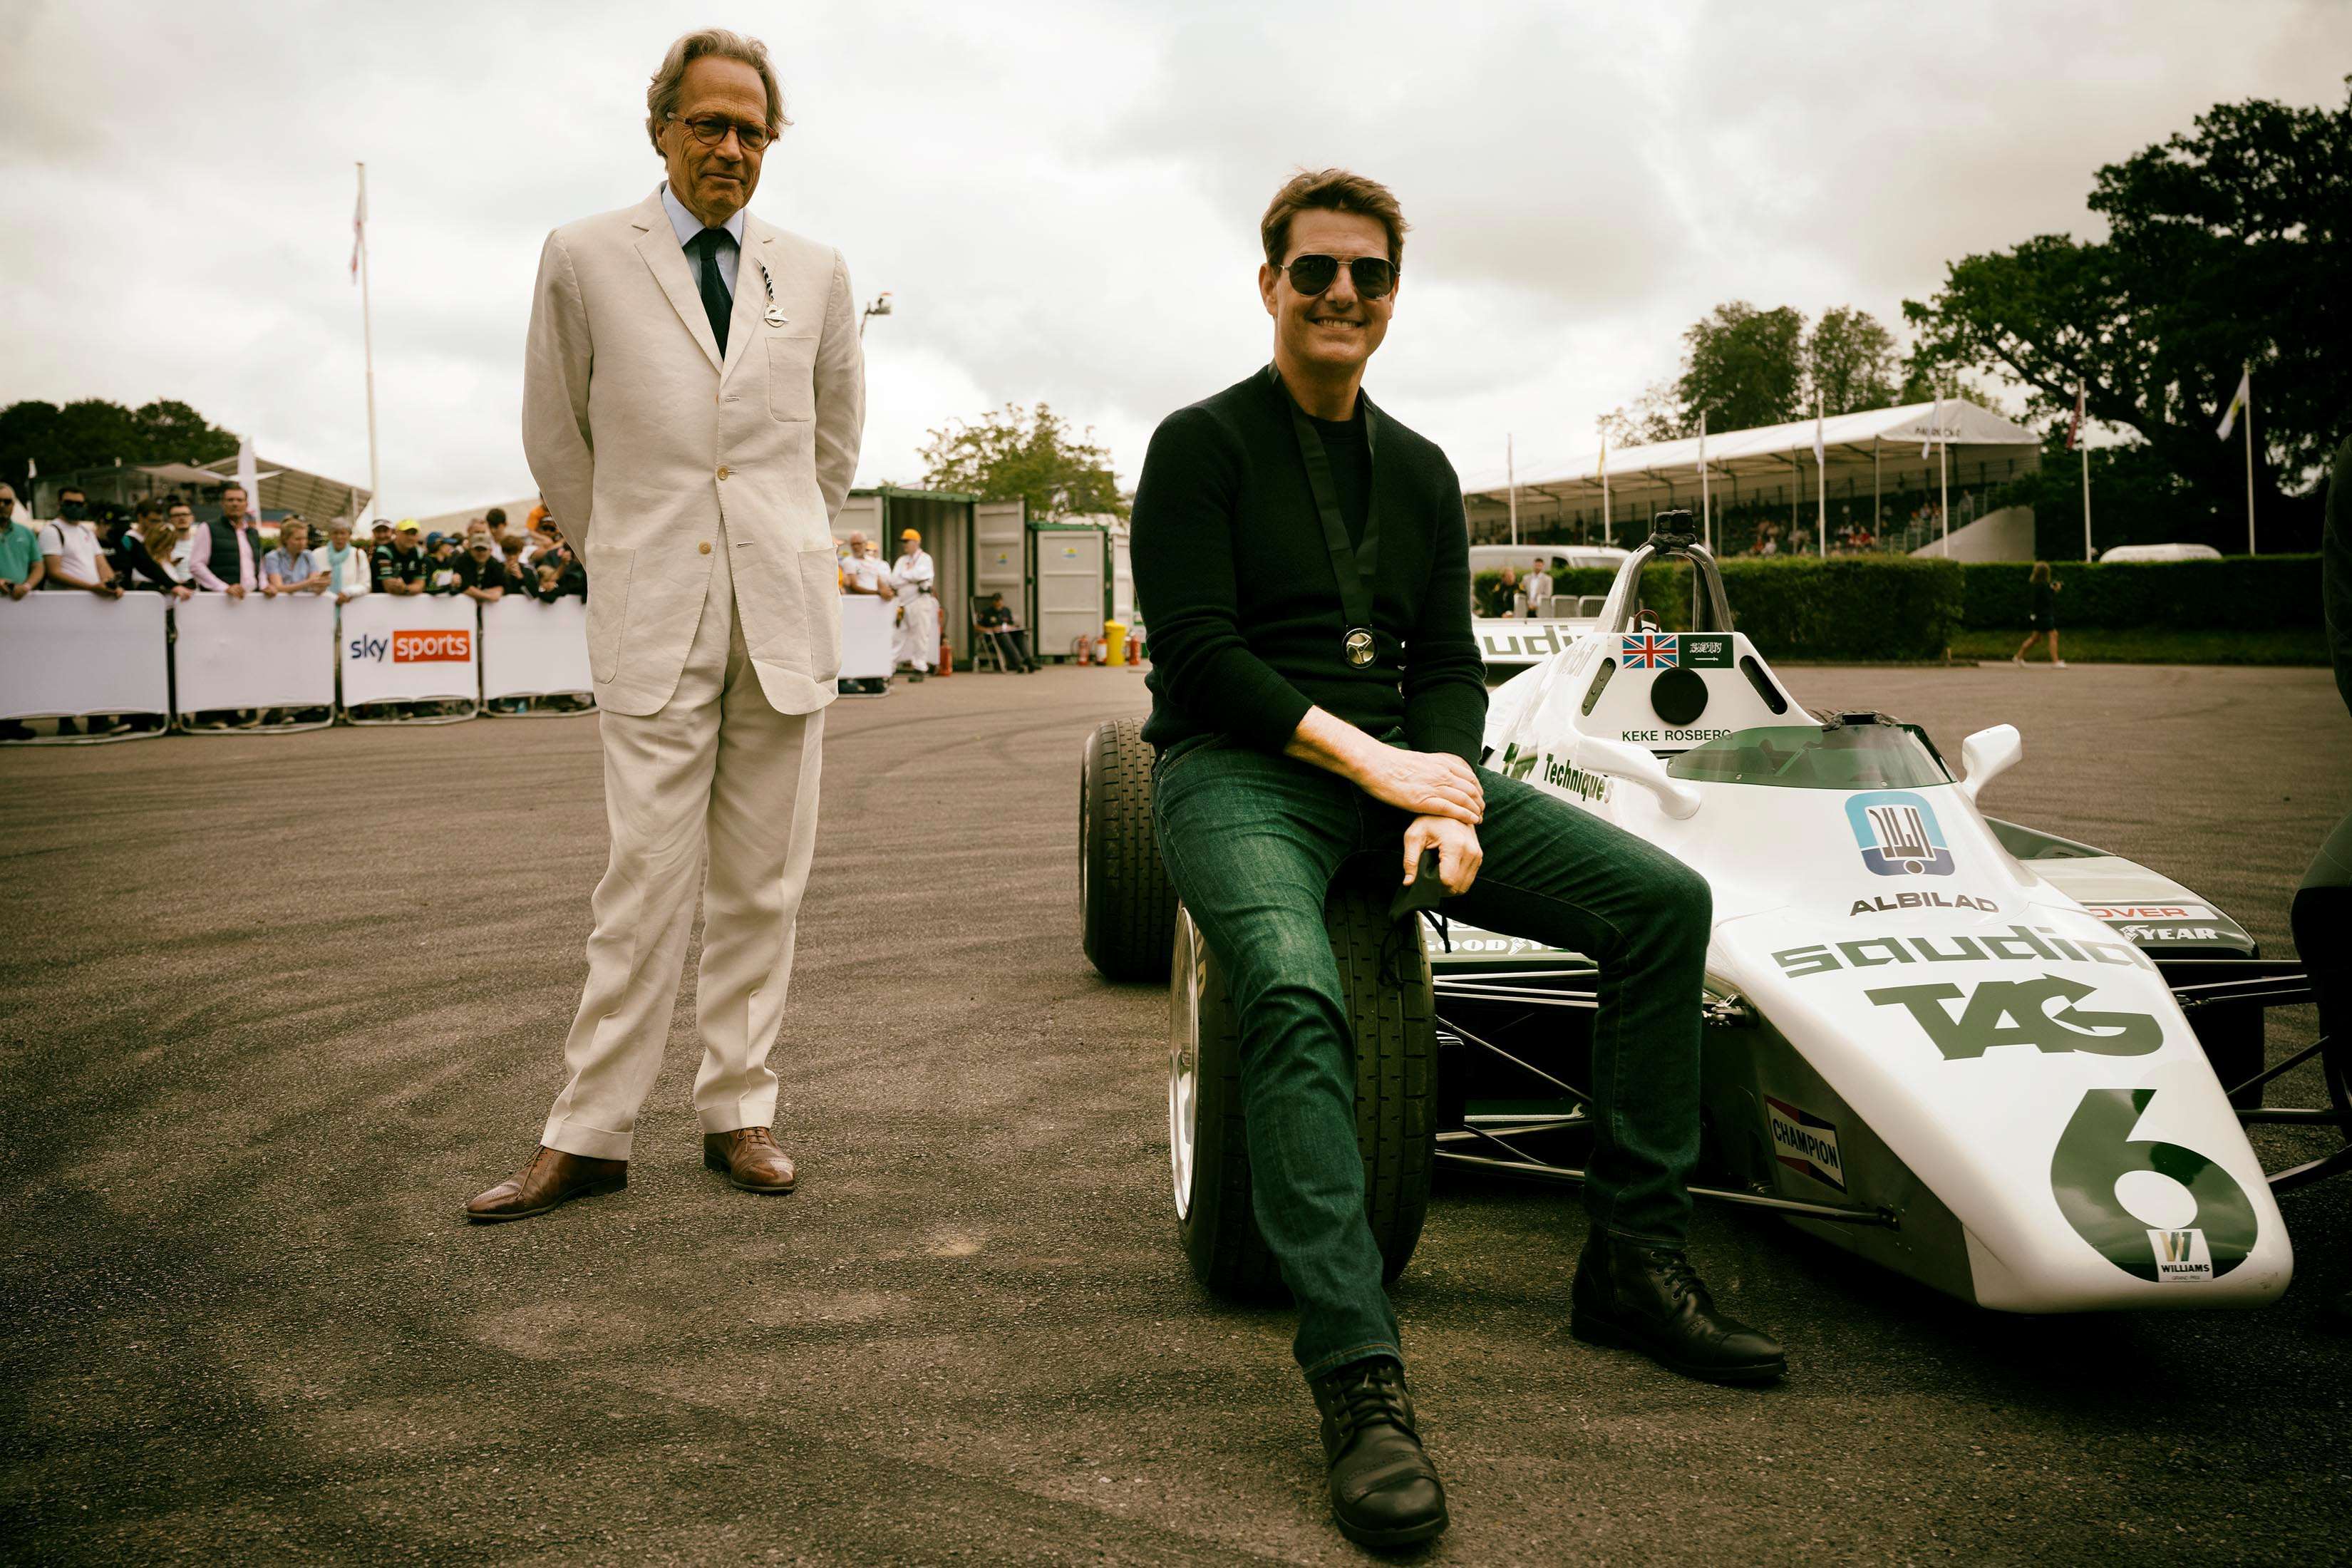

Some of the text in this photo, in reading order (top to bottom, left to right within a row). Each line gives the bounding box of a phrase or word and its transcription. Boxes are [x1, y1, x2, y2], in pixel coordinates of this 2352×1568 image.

[351, 634, 468, 663] sky sports
[1622, 729, 1733, 741] KEKE ROSBERG
[1543, 752, 1614, 804] Techniques
[1849, 892, 2000, 917] ALBILAD
[1770, 924, 2157, 979] saudia
[2138, 927, 2219, 940] YEAR
[1862, 972, 2165, 1061] TAG
[1772, 1118, 1840, 1170] CHAMPION
[2050, 1088, 2258, 1283] 6
[2160, 1264, 2210, 1273] WILLIAMS
